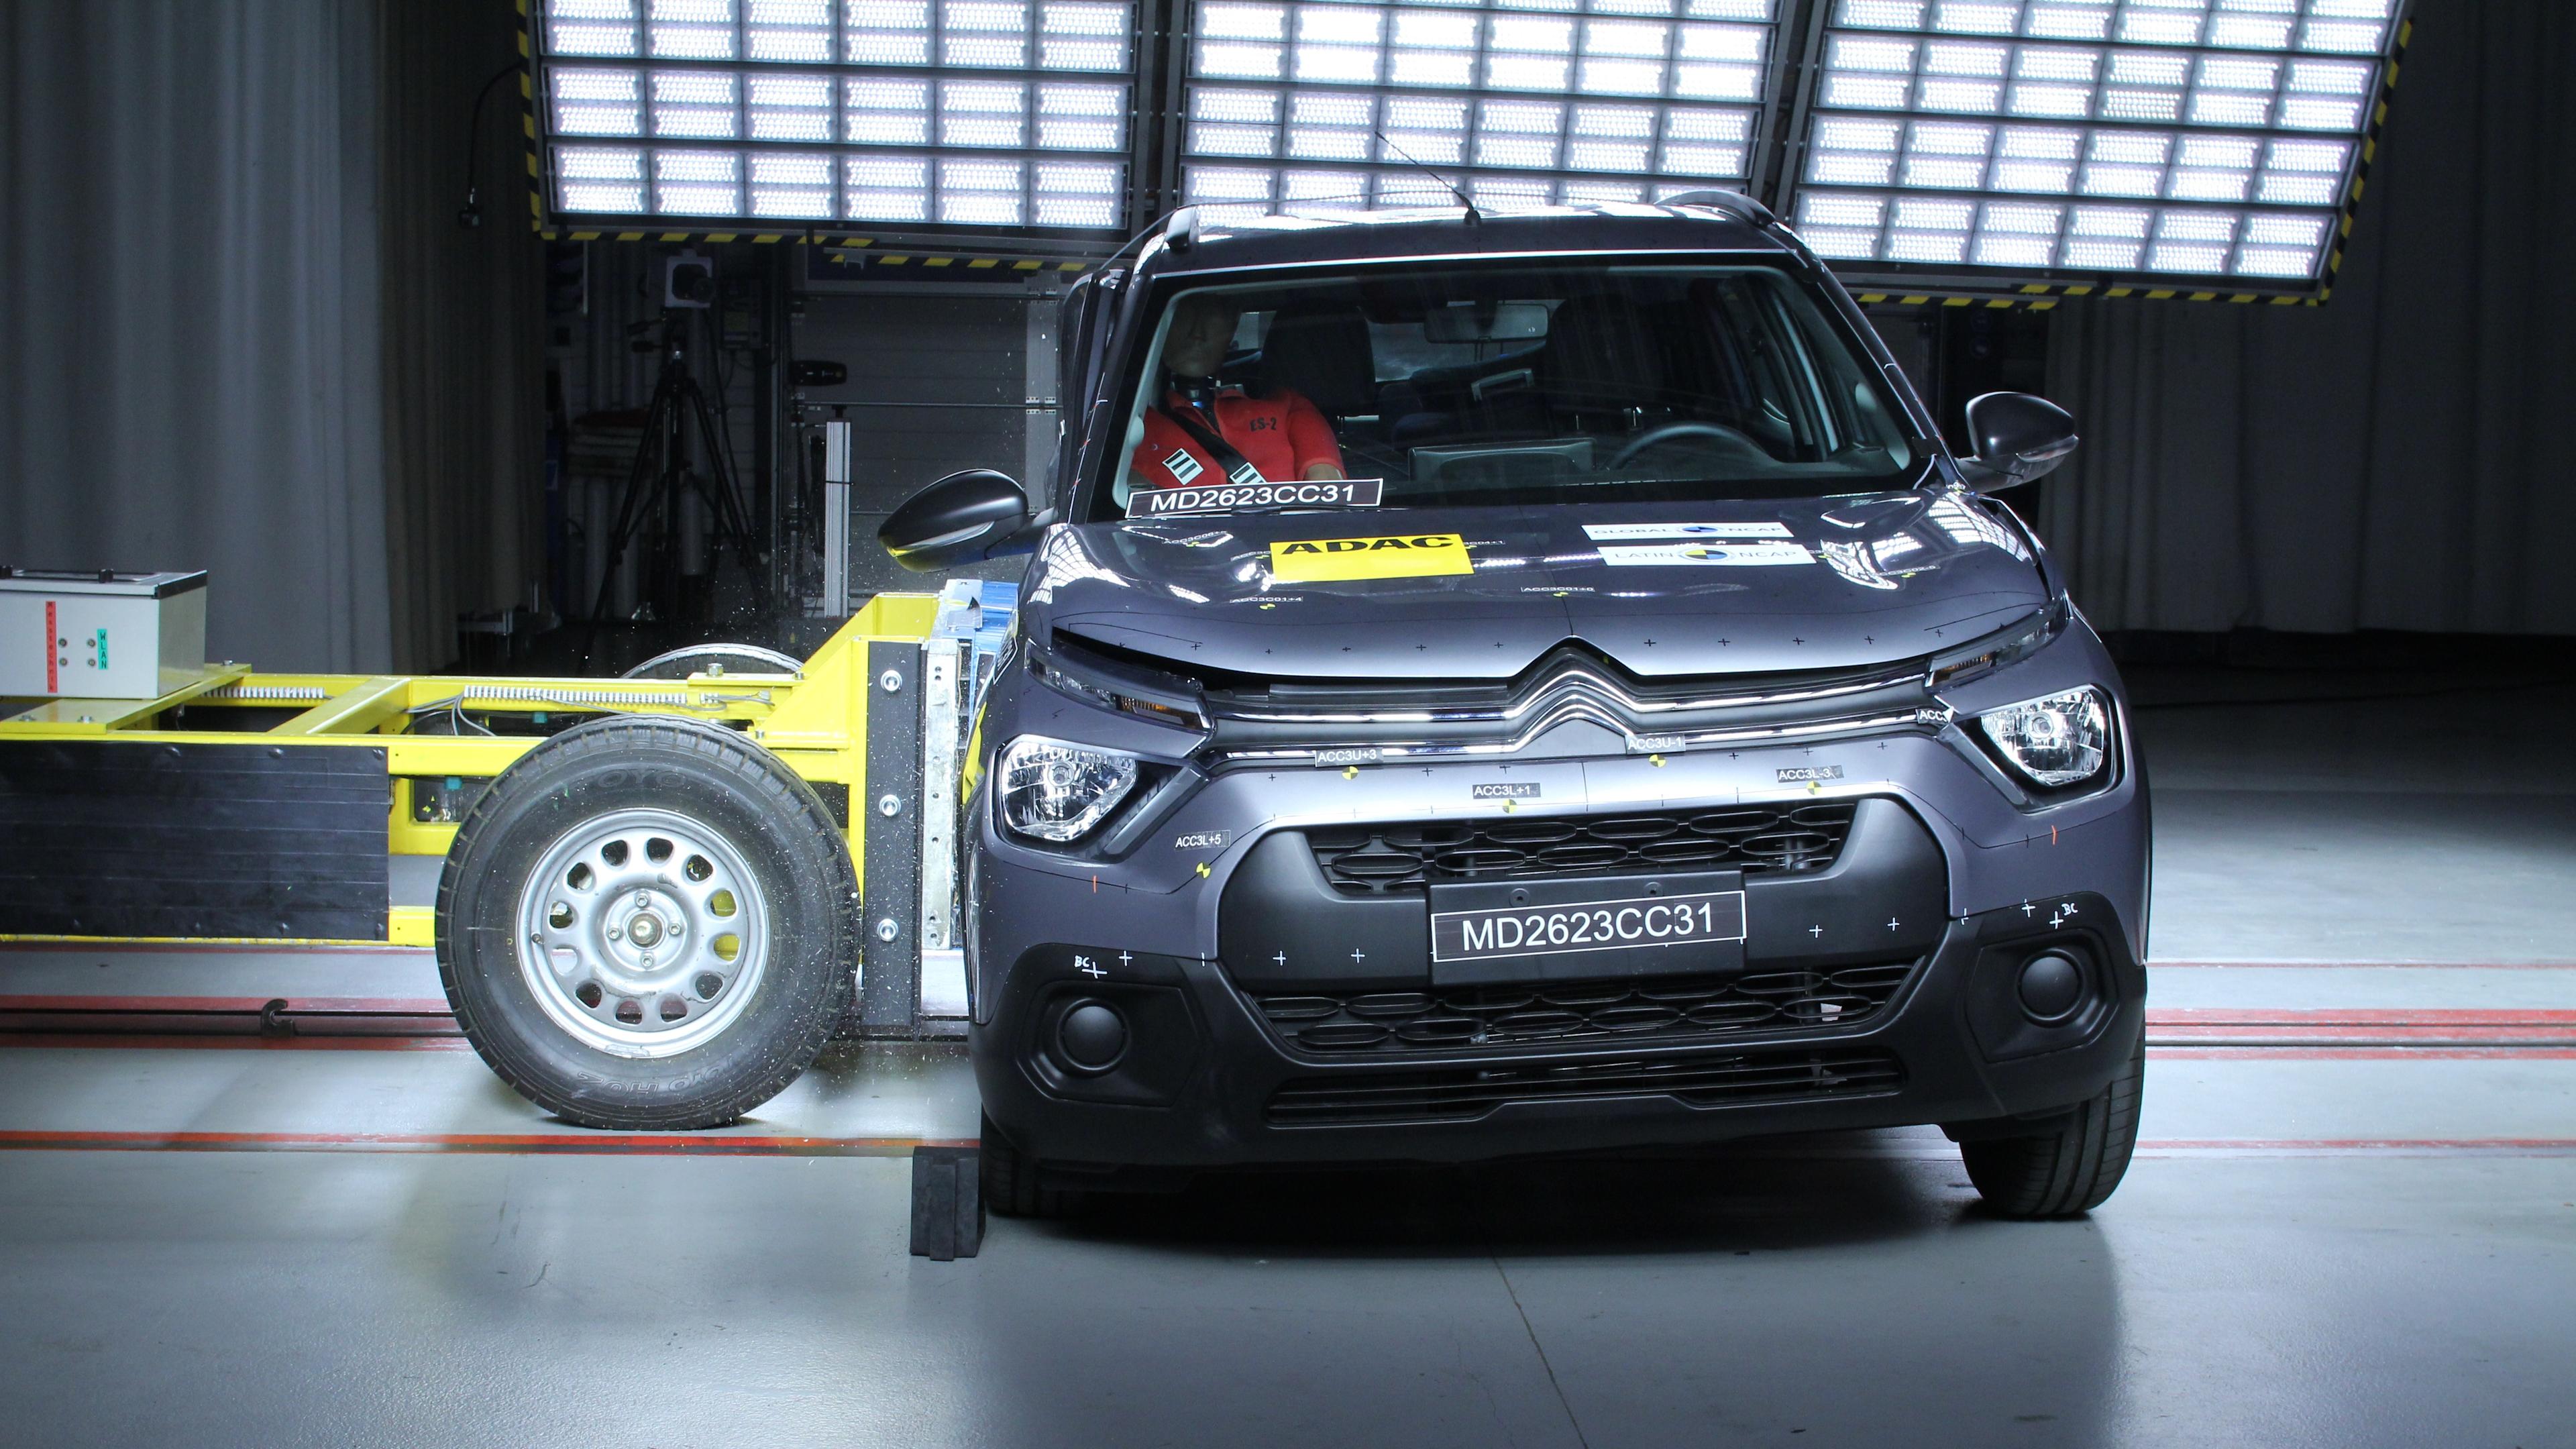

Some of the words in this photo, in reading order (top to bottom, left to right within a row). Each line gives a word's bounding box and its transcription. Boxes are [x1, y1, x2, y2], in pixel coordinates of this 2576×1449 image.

[1250, 417, 1277, 431] ES-2
[1150, 484, 1354, 511] MD2623CC31
[1281, 537, 1454, 555] ADAC
[1627, 736, 1682, 750] ACC3U-1
[1317, 749, 1377, 763] ACC3U+3
[1778, 768, 1831, 780] ACC3L-3
[1474, 785, 1530, 796] ACC3L+1
[1175, 834, 1222, 848] ACC3L+5
[1462, 902, 1713, 951] MD2623CC31
[1074, 955, 1090, 967] BC
